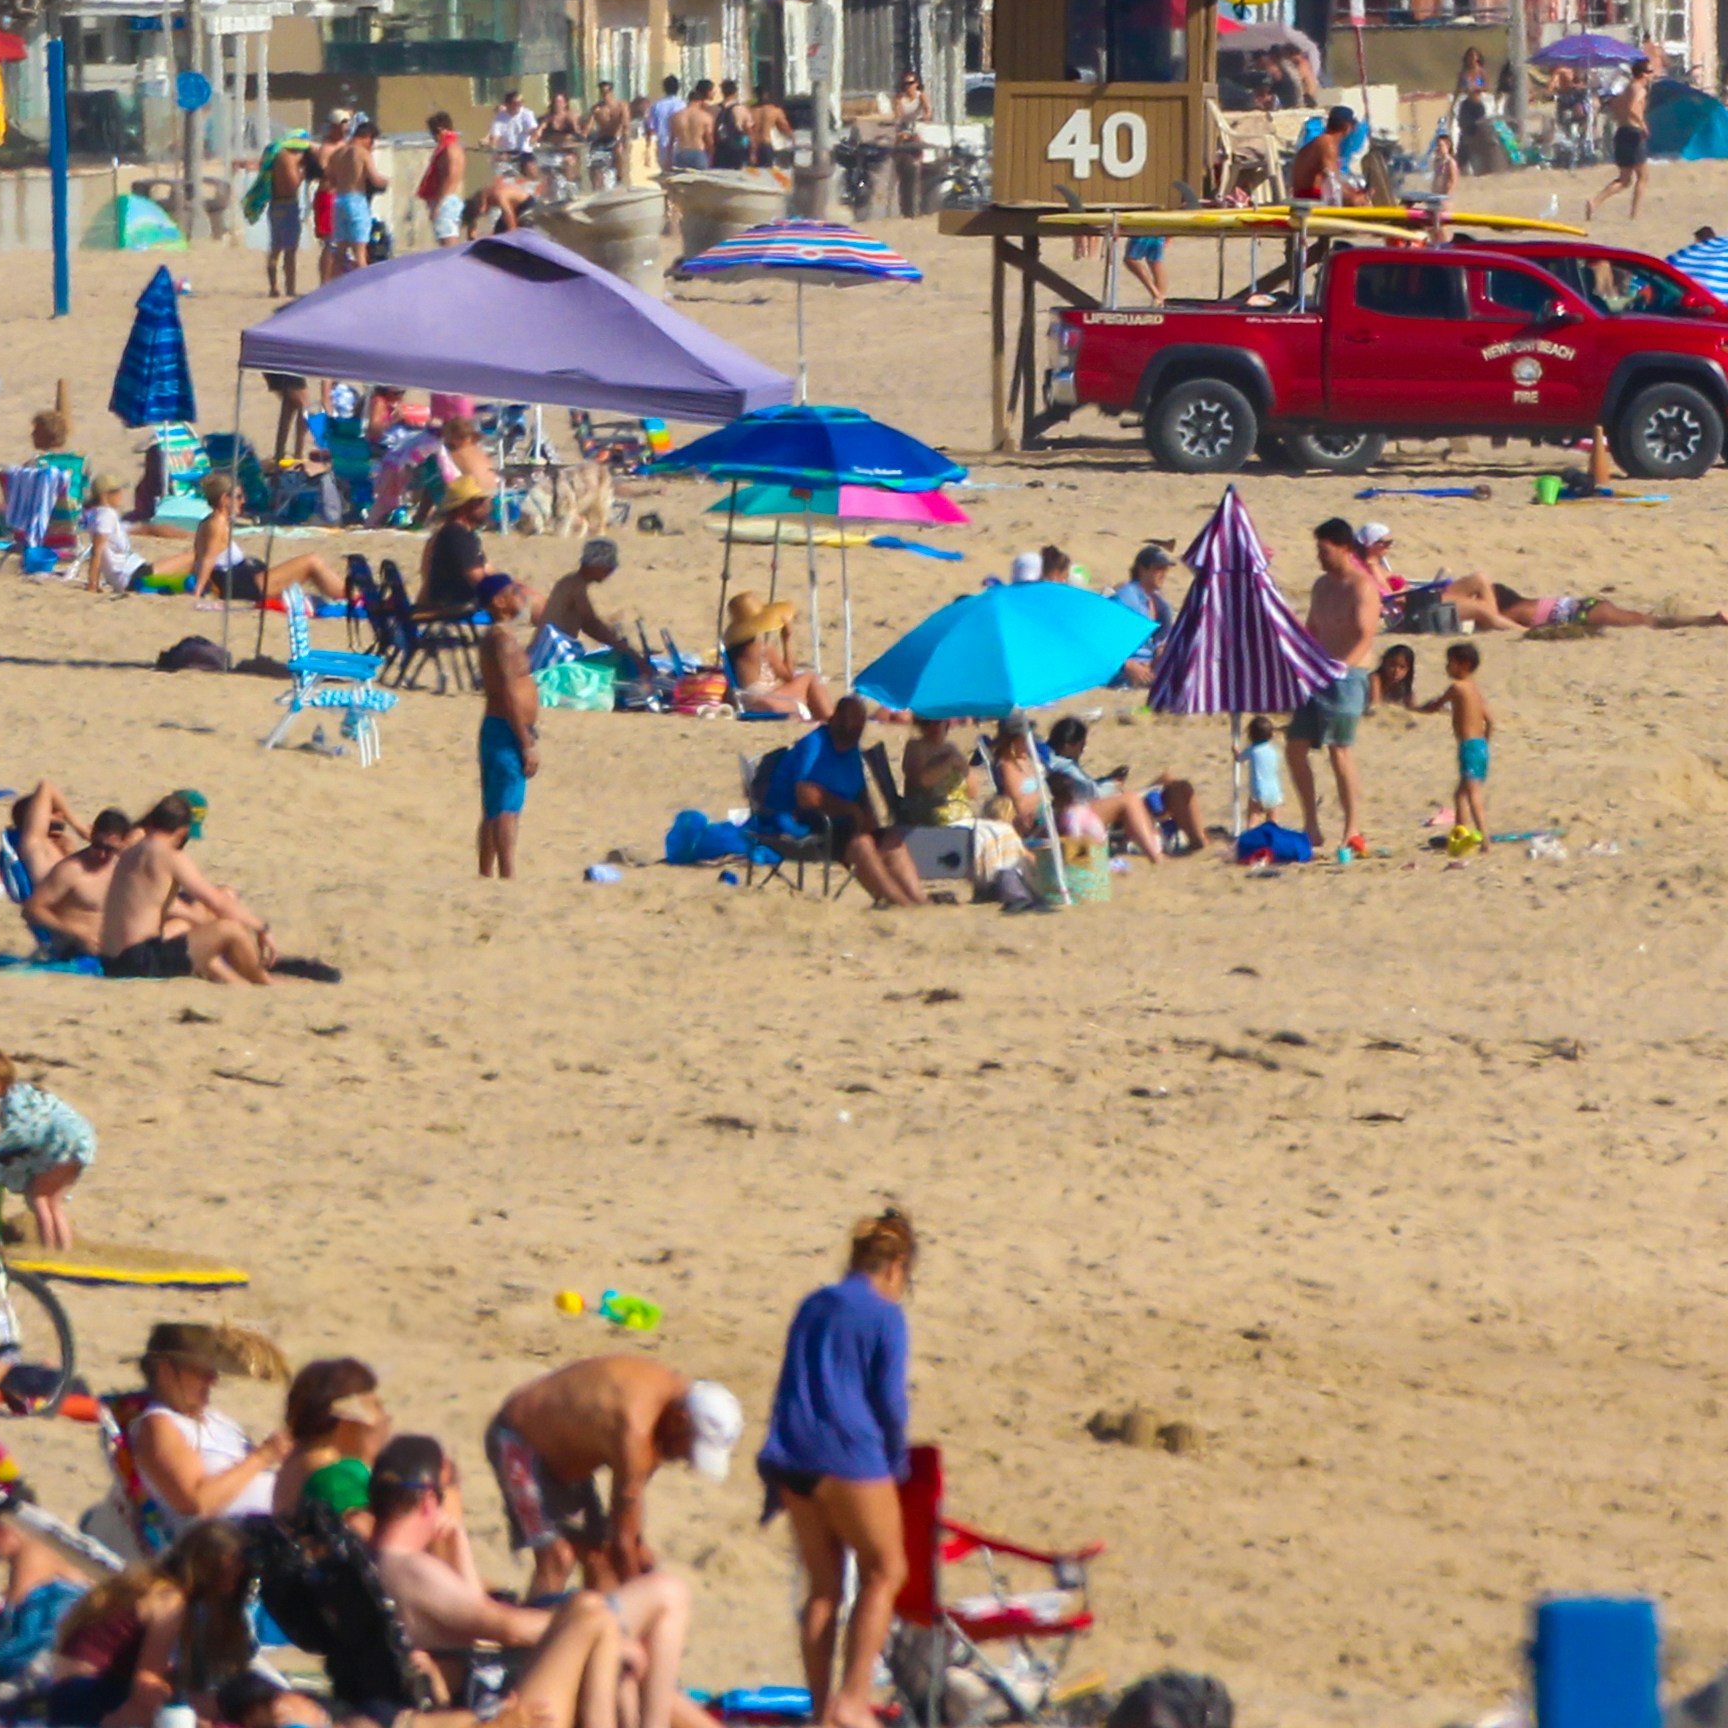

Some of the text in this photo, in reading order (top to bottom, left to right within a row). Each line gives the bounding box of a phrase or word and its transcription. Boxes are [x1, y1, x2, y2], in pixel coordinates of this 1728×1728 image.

[1047, 108, 1148, 179] 40
[1082, 311, 1164, 326] LIFEGUARD
[1536, 339, 1577, 362] BEACH
[1513, 390, 1539, 404] FIRE
